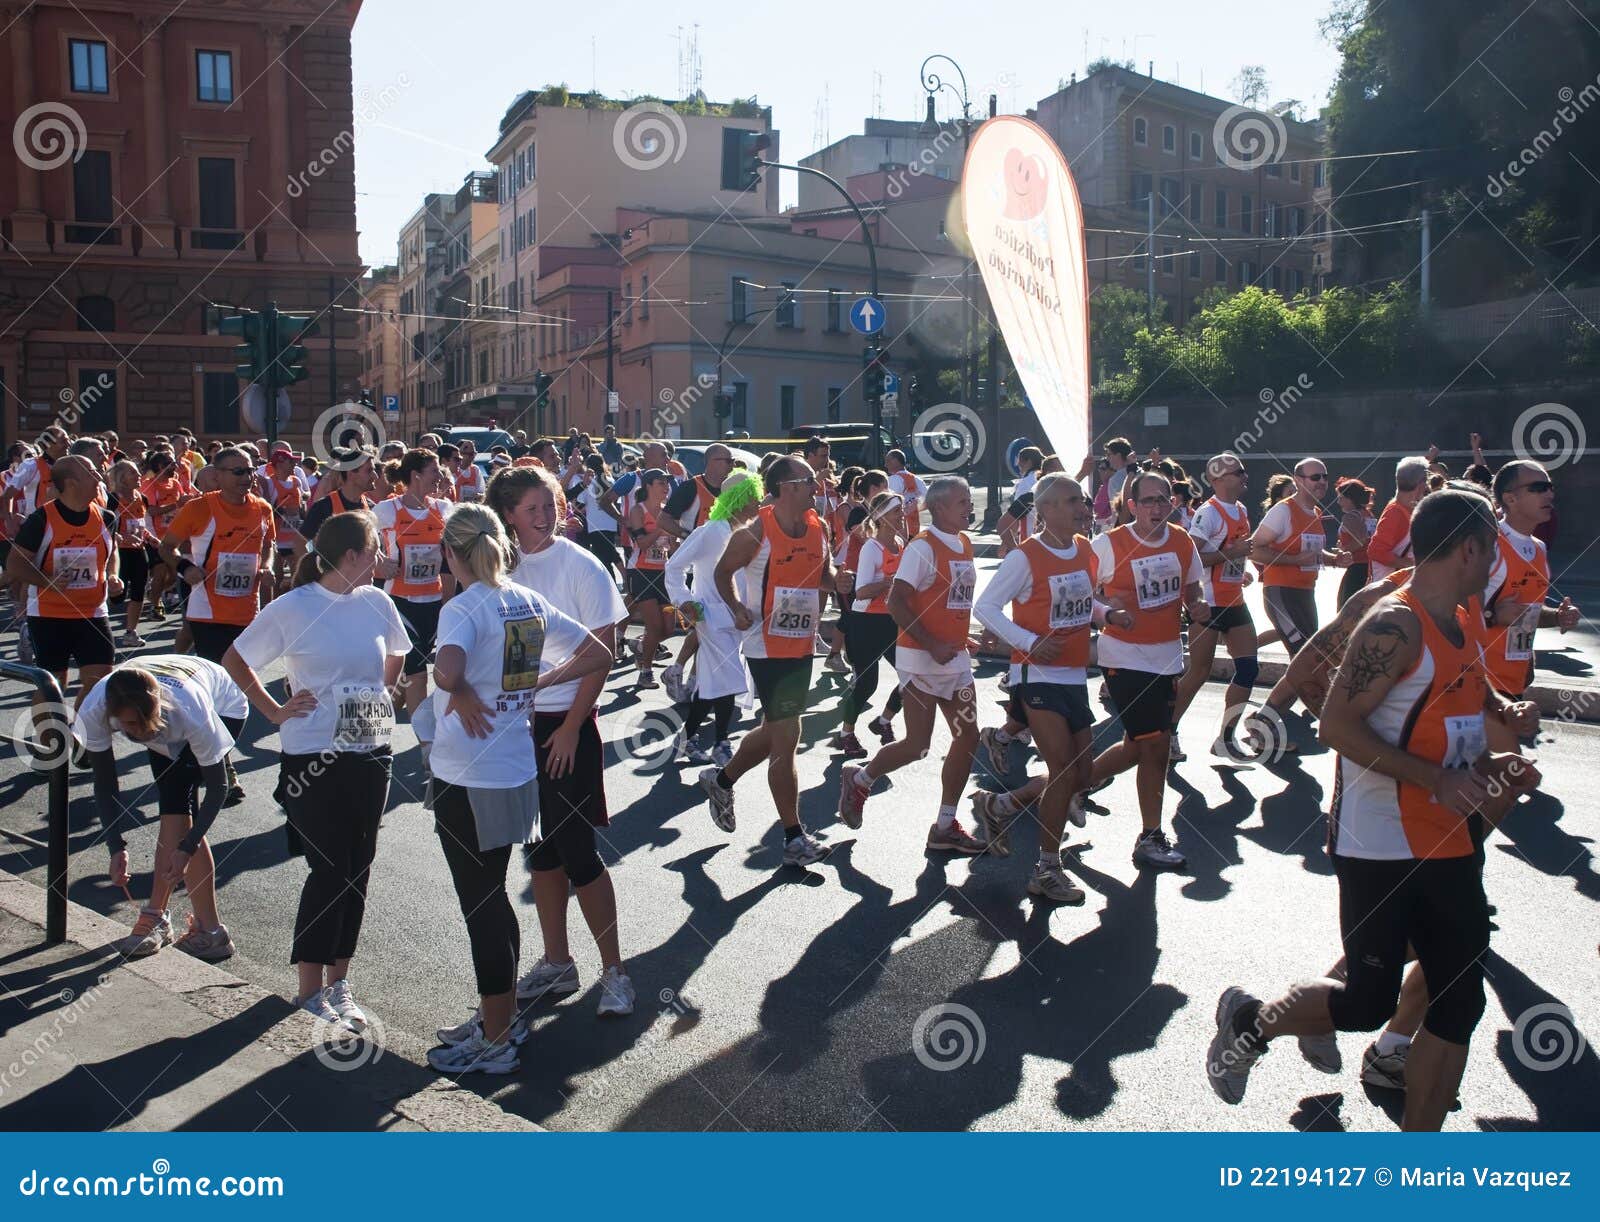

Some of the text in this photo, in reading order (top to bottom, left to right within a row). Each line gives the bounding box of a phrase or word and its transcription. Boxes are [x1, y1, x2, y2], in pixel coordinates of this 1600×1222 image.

[386, 396, 396, 410] P
[412, 564, 435, 577] 621
[222, 575, 250, 589] 203
[1140, 576, 1180, 598] 1310
[1055, 597, 1092, 618] 1309
[778, 613, 811, 629] 236
